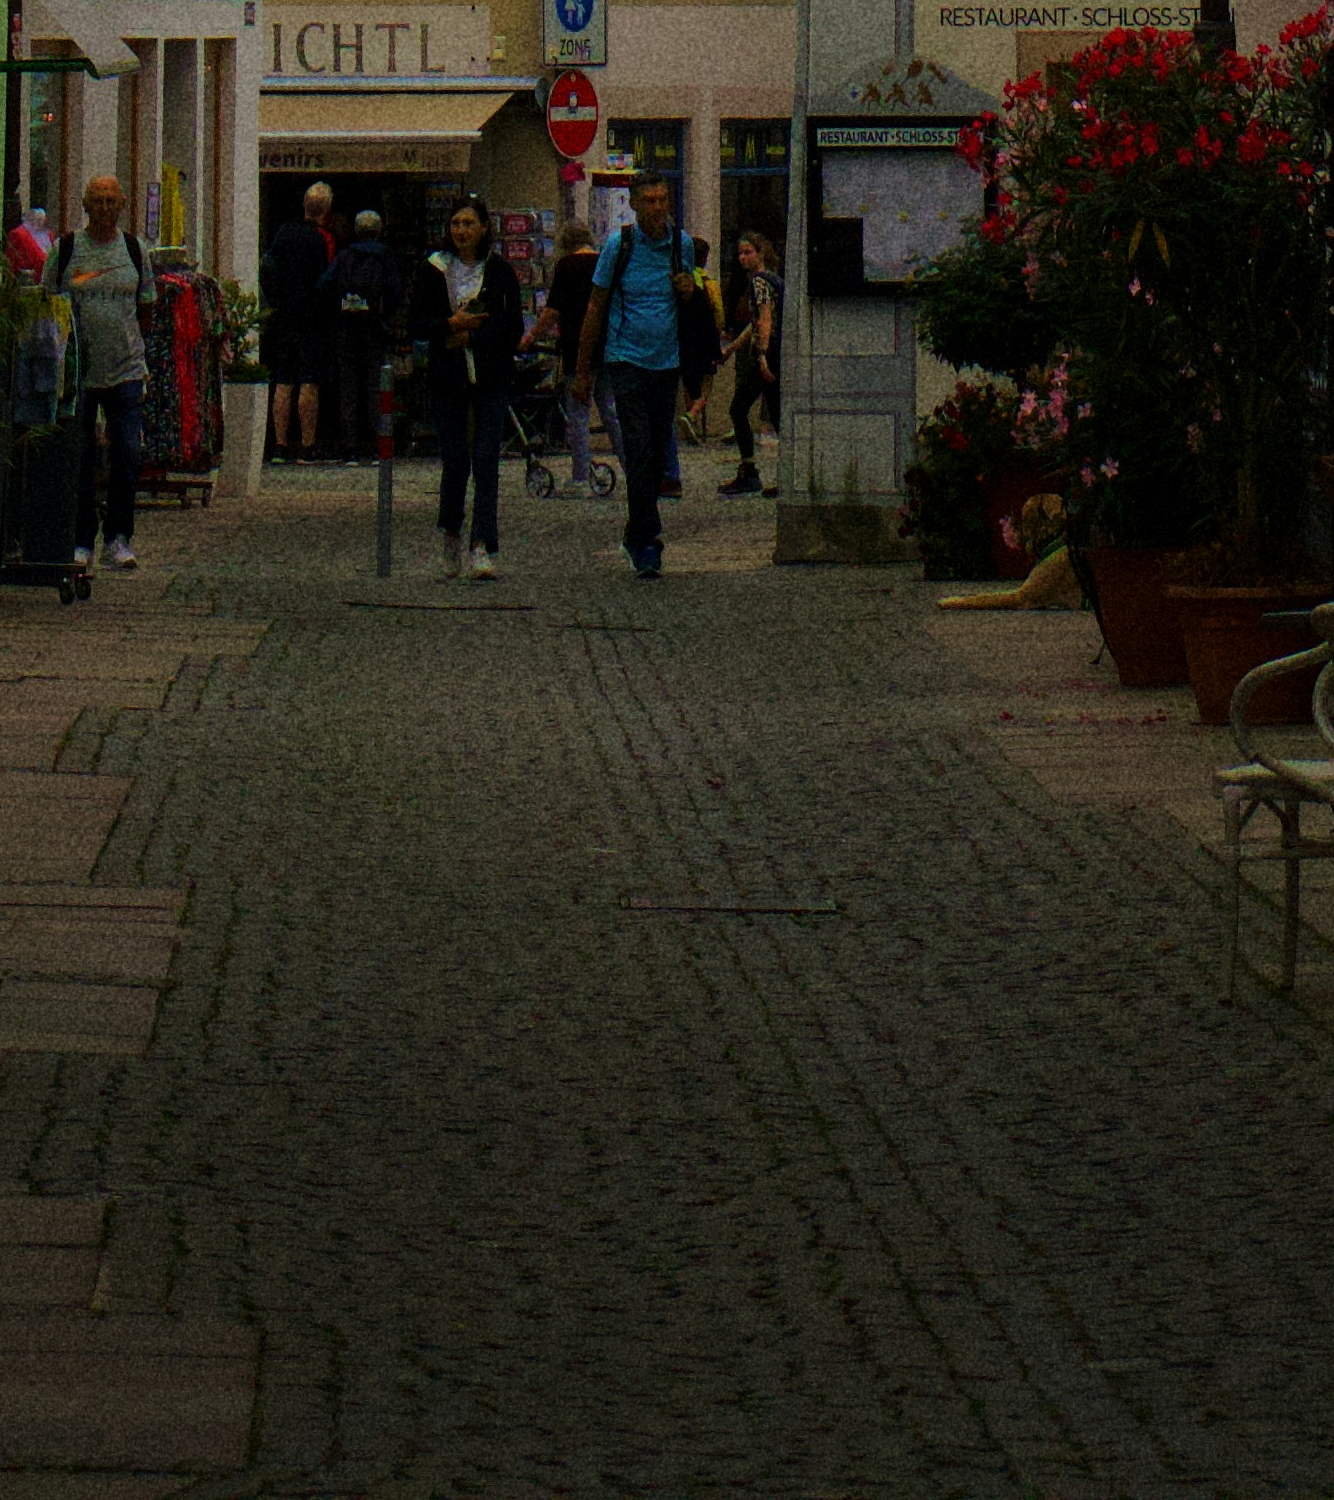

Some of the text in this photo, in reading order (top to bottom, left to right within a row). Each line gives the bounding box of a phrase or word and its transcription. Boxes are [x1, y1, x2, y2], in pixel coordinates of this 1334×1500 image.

[940, 7, 1067, 27] RESTAURANT
[272, 21, 446, 74] ICHTL
[820, 130, 889, 144] RESTAURANT
